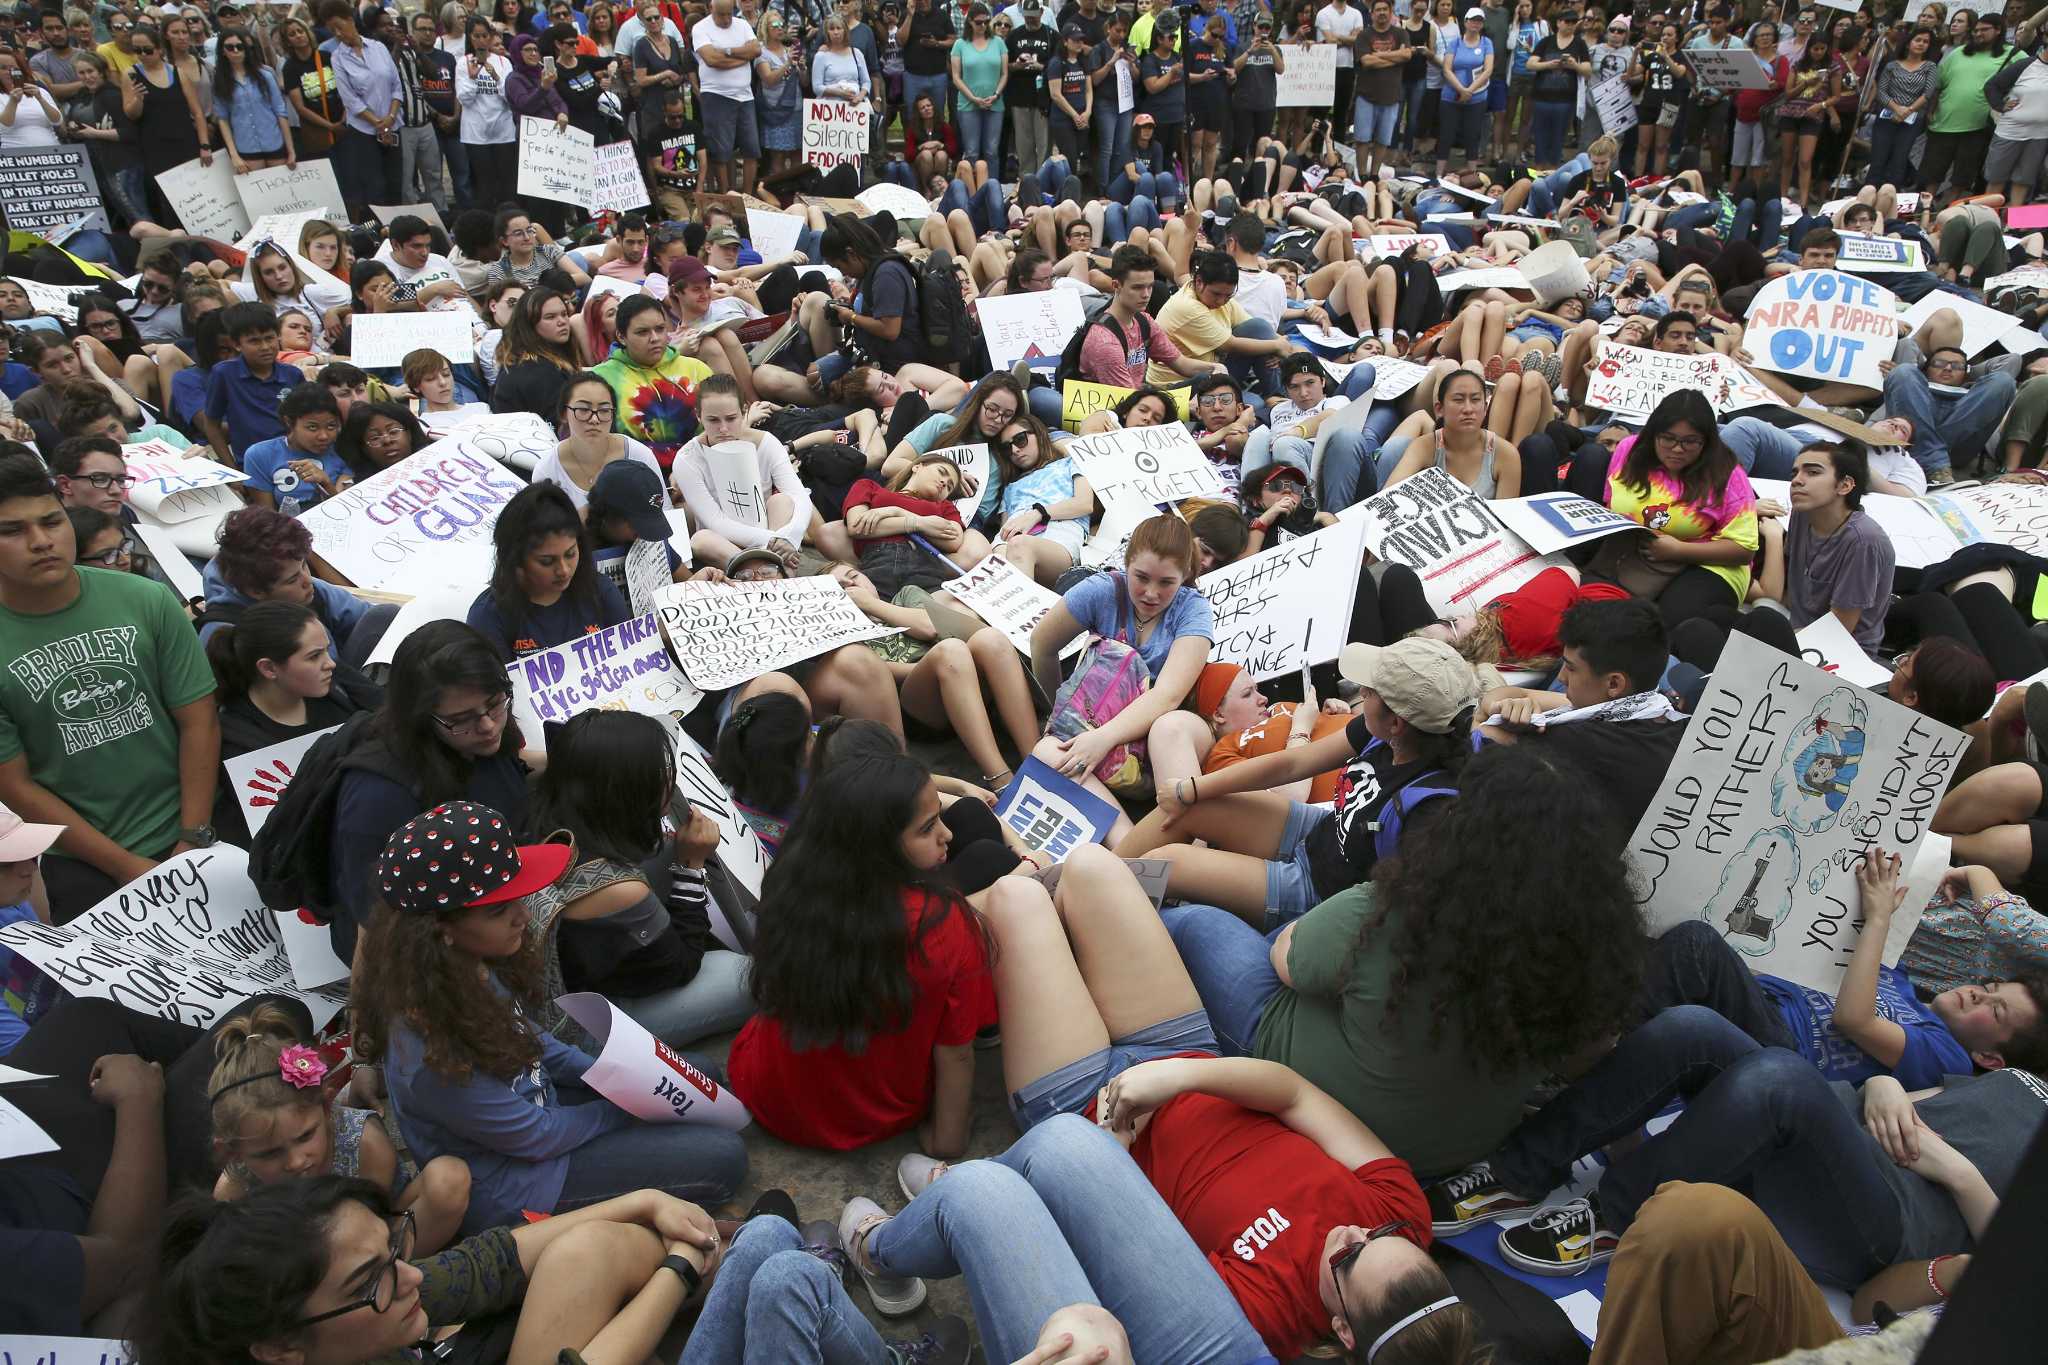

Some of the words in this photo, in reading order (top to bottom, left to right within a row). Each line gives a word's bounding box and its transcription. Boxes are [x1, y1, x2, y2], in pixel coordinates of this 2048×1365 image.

[811, 103, 833, 122] NO
[834, 104, 866, 126] More
[661, 133, 696, 149] IMAGINE
[803, 123, 866, 151] Silence
[0, 156, 14, 168] HE
[16, 155, 62, 167] NUMBER
[64, 153, 80, 164] OF
[39, 168, 76, 181] HOLES
[1, 188, 14, 199] IN
[15, 186, 42, 197] THIS
[43, 183, 87, 196] POSTER
[250, 167, 322, 194] THOUGHTS
[7, 202, 30, 214] ARE
[53, 196, 101, 210] NUMBER
[42, 215, 66, 227] CAN
[1785, 271, 1880, 308] VOTE
[1750, 300, 1821, 330] NRA
[1829, 304, 1894, 339] PUPPETS
[1652, 354, 1686, 370] DID
[1769, 328, 1865, 379] OUT
[1636, 380, 1667, 394] OUR
[1071, 431, 1125, 463] NOT
[1135, 427, 1189, 451] YOUR
[365, 443, 489, 527] CHILDREN
[413, 468, 523, 541] GUNS
[661, 591, 756, 624] DISTRICT
[1212, 589, 1279, 630] YERS
[673, 621, 761, 649] DISTRICT
[788, 611, 857, 628] (SMITH)
[1213, 624, 1260, 663] ICY
[8, 626, 138, 703] BRADLEY
[507, 651, 566, 694] ND
[571, 628, 619, 671] THE
[618, 612, 659, 651] NRA
[1236, 643, 1296, 677] ANGE
[580, 663, 634, 701] gotten
[632, 647, 671, 677] away
[57, 691, 154, 756] ATHLETICS
[1693, 688, 1743, 754] YOU
[1695, 662, 1800, 854] RATHER?
[1894, 734, 1967, 845] CHOOSE.
[1007, 792, 1044, 834] LIV
[1019, 806, 1064, 851] FOR
[1801, 895, 1849, 951] YOU
[658, 1041, 713, 1093] Students
[651, 1075, 694, 1117] Text
[1232, 1206, 1293, 1263] VOLS
